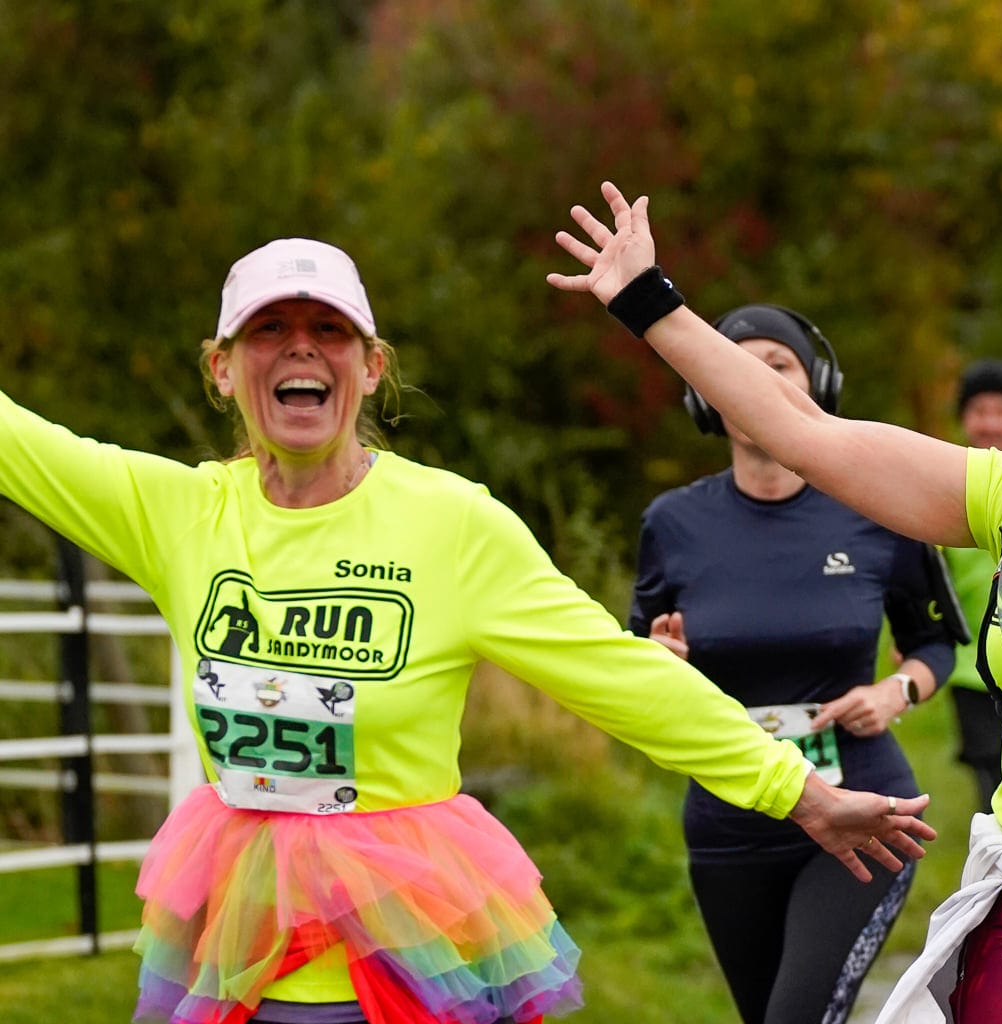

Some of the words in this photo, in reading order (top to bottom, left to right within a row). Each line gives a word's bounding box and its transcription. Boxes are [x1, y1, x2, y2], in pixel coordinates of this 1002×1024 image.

[334, 559, 412, 583] Sonia
[280, 605, 373, 643] RUN
[267, 639, 385, 663] SANDYMOOR
[200, 708, 347, 776] 2251
